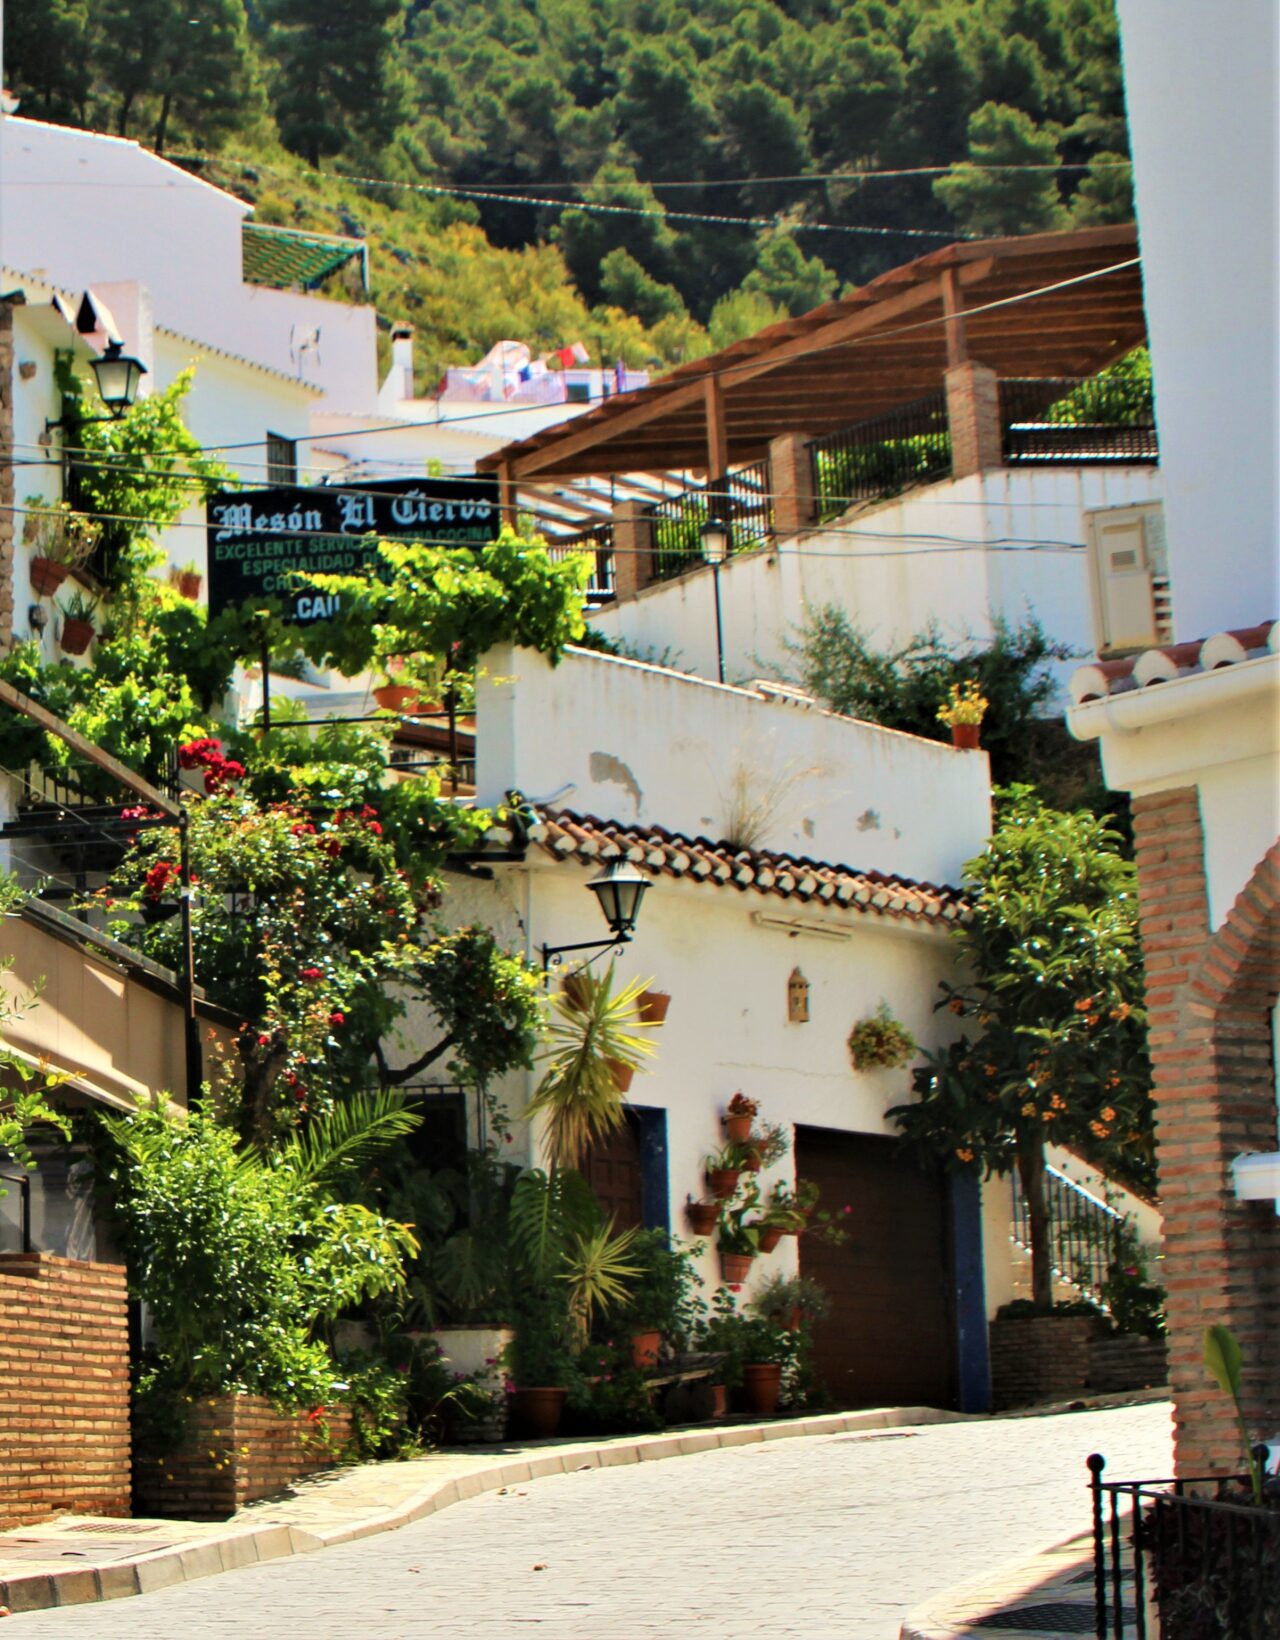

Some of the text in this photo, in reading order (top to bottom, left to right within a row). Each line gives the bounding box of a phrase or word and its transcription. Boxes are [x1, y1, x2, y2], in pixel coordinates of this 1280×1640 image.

[213, 488, 492, 542] Mesón El Ciervo
[215, 540, 303, 559] EXCELENTE
[308, 535, 378, 553] SERVIC
[436, 526, 493, 543] COCINA
[242, 553, 355, 576] ESPECIALIDAD
